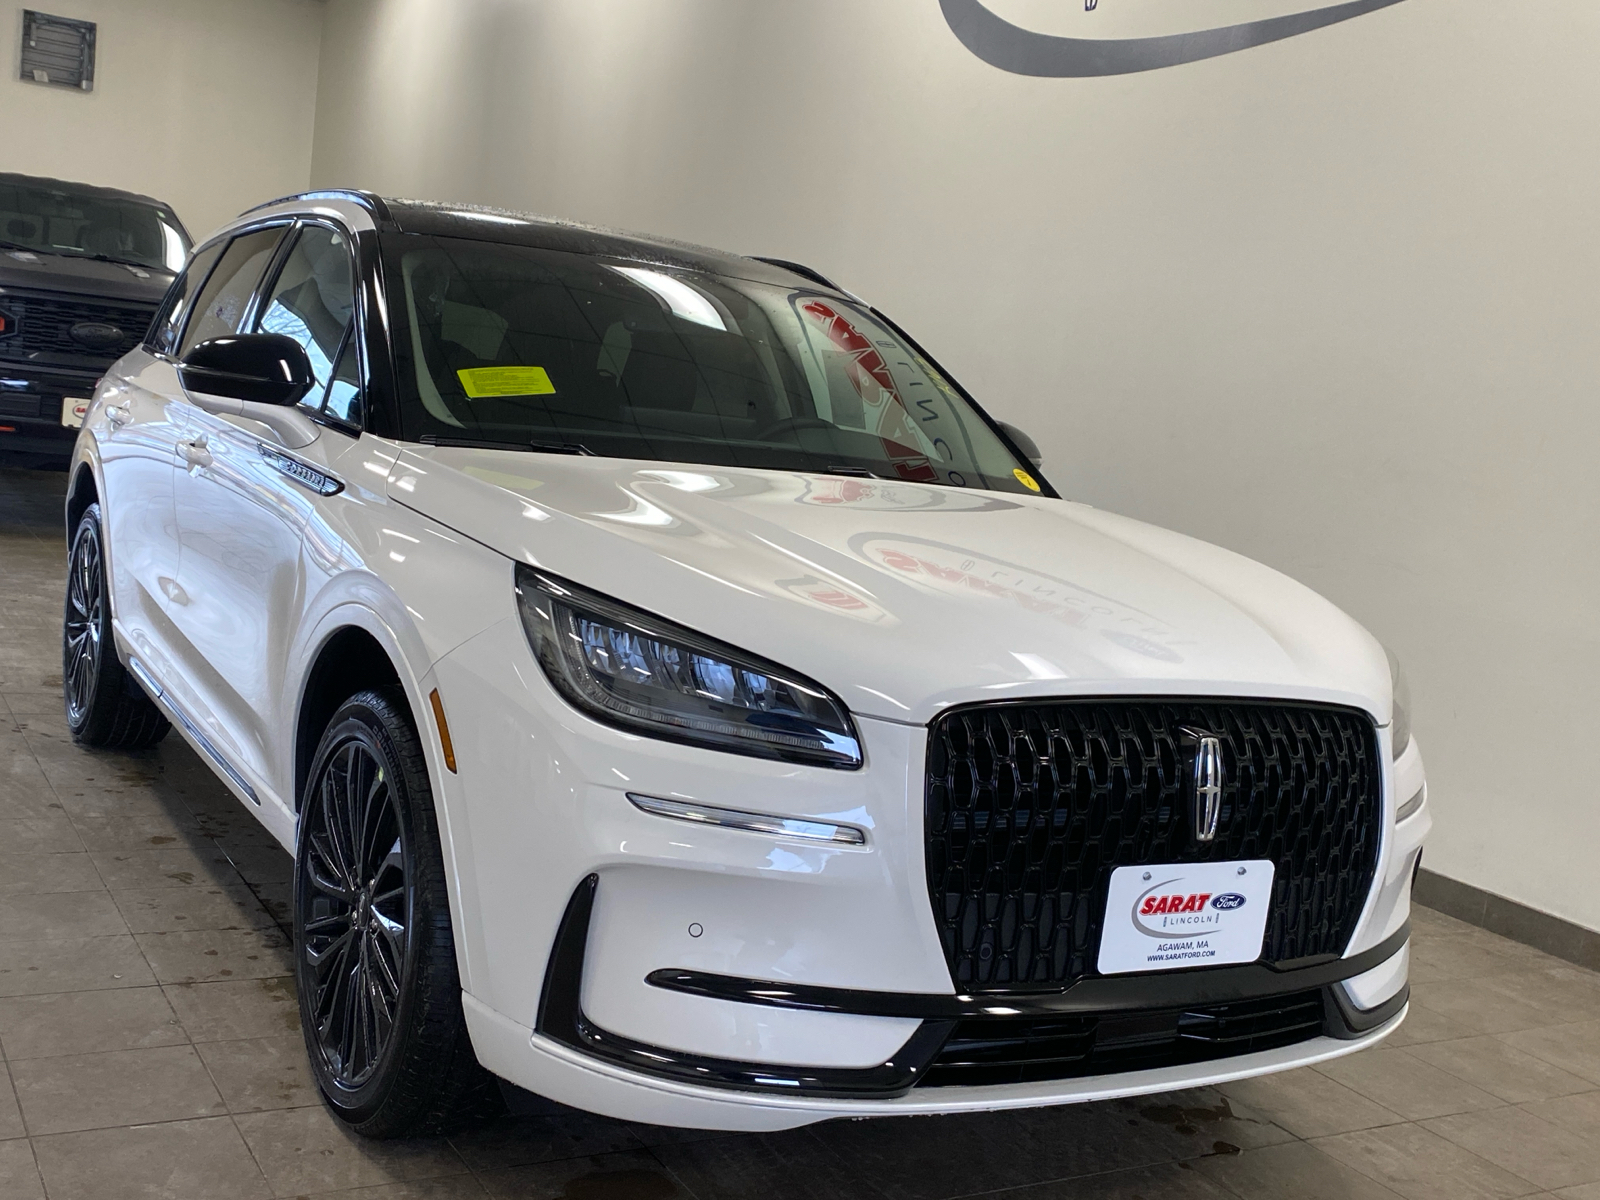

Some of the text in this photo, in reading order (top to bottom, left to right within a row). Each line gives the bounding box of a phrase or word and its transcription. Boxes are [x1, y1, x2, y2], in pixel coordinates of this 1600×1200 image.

[1140, 893, 1237, 915] SARAT Ford
[1171, 916, 1212, 925] LINCOLN
[1157, 940, 1209, 952] AGAWAM, MA
[1147, 951, 1215, 961] WWW.SARATFORD.COM
